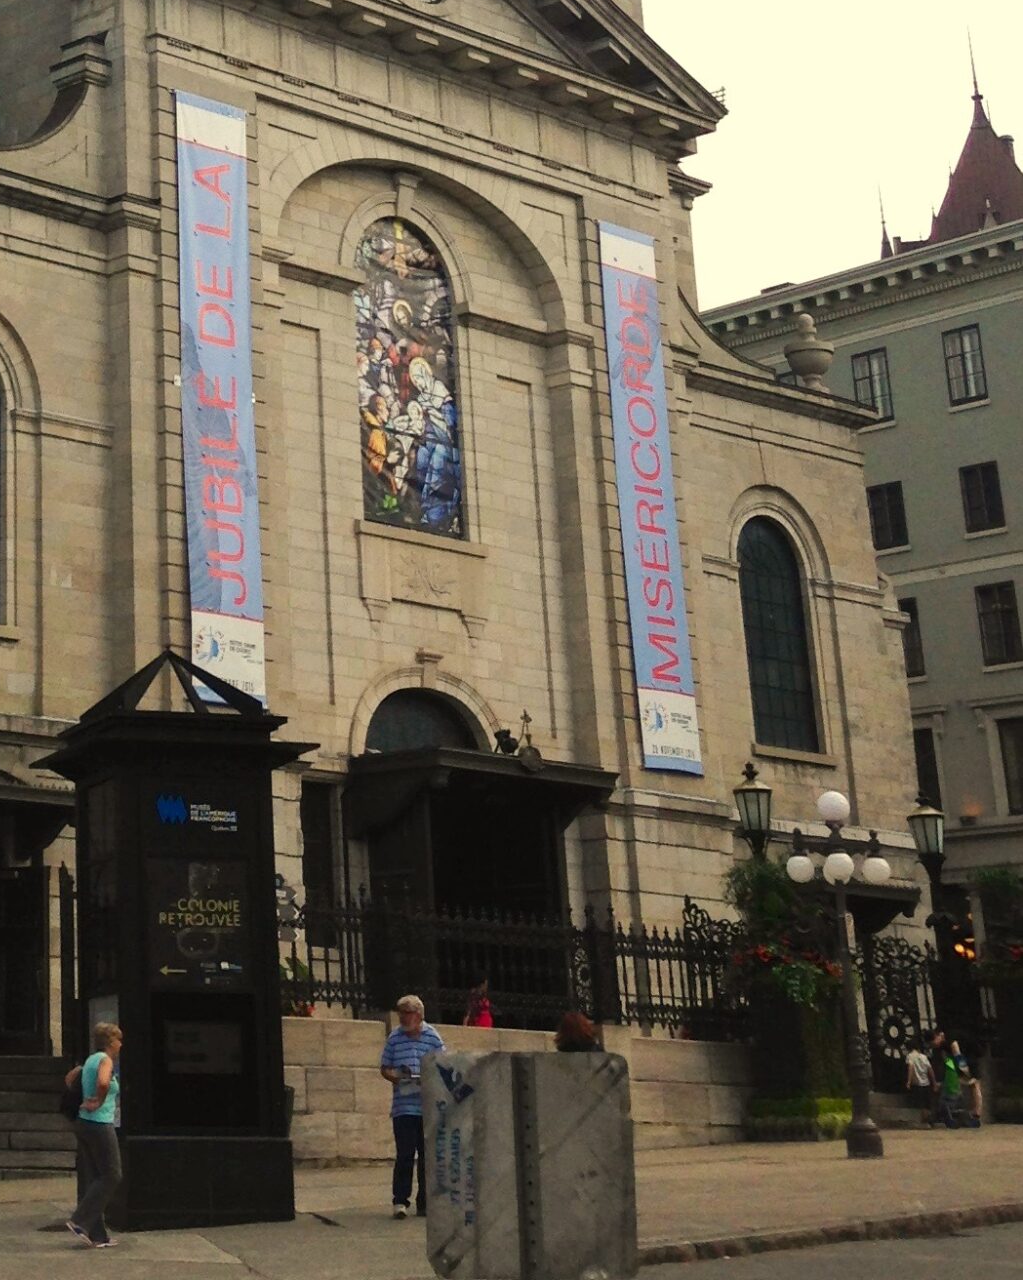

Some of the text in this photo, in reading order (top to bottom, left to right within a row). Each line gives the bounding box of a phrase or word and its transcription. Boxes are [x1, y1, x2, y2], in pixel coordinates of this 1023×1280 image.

[192, 163, 232, 239] LA
[196, 259, 236, 348] DE
[191, 368, 248, 606] JUBILÉ
[616, 277, 681, 684] MISÉRICORDE
[158, 911, 241, 928] RETROUVÉE
[177, 898, 241, 913] COLONIE
